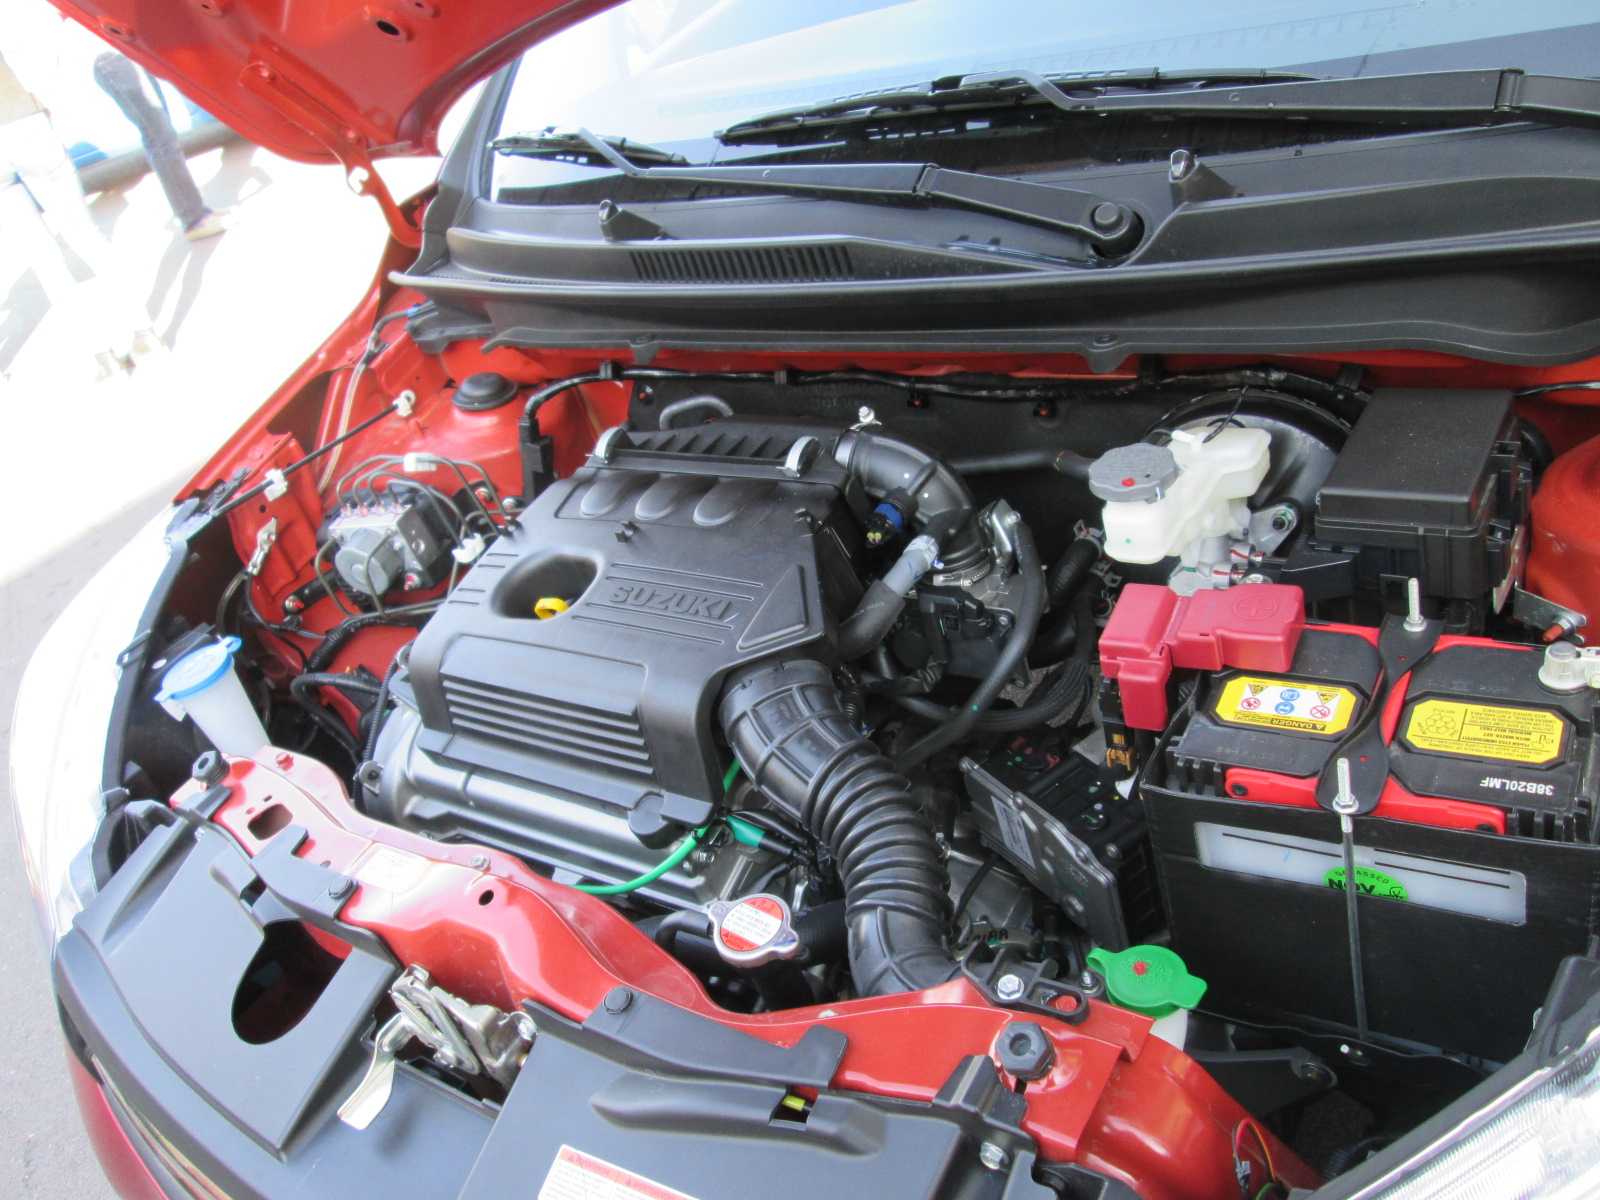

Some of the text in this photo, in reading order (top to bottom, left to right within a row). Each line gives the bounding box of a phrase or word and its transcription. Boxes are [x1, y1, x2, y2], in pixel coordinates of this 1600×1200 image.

[610, 585, 732, 621] SUZUKI
[1272, 719, 1313, 729] DANGER
[1480, 776, 1554, 796] 38B20LMF
